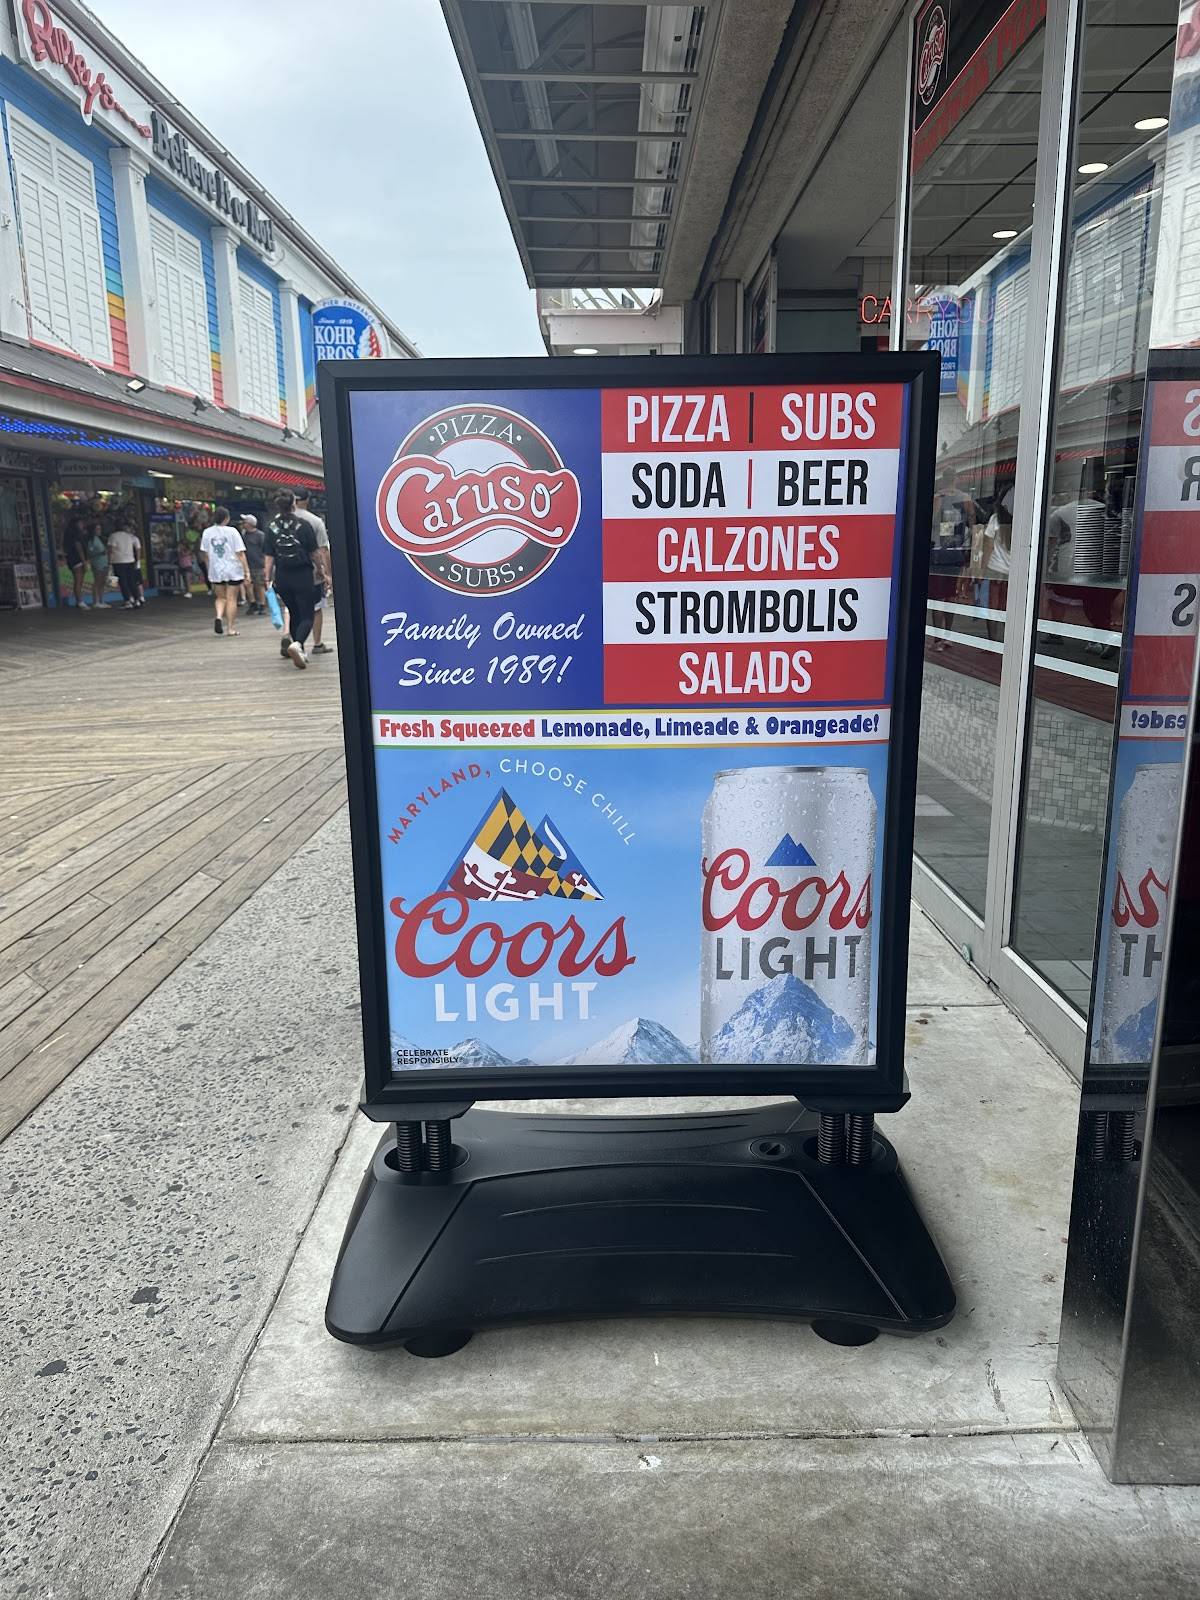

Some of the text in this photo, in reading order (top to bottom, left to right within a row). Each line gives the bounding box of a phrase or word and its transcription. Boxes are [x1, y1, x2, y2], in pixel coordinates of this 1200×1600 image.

[21, 0, 116, 115] Ripley's
[150, 109, 276, 252] Believe It or Not!
[314, 325, 357, 345] KOHR
[316, 345, 355, 360] BROS
[432, 413, 517, 445] PIZZA
[626, 390, 877, 444] PIZZA SUBS
[385, 465, 564, 546] Caruso
[631, 459, 869, 509] SODA BEER
[656, 523, 841, 574] CALZONES
[447, 562, 517, 588] SUBS
[380, 611, 586, 649] Family Owned
[634, 587, 860, 635] STROMBOLIS
[398, 654, 573, 687] Since 1989!
[678, 649, 813, 696] SALADS
[379, 713, 880, 741] Fresh Squeezed Lemonade, Limeade & Orangeade!
[387, 758, 640, 847] MARYLAND, CHOOSE CHILL
[701, 847, 872, 932] Coors
[389, 890, 637, 979] Coors
[715, 935, 862, 980] LIGHT
[434, 981, 599, 1022] LIGHT
[396, 1048, 449, 1057] CELEBRATE
